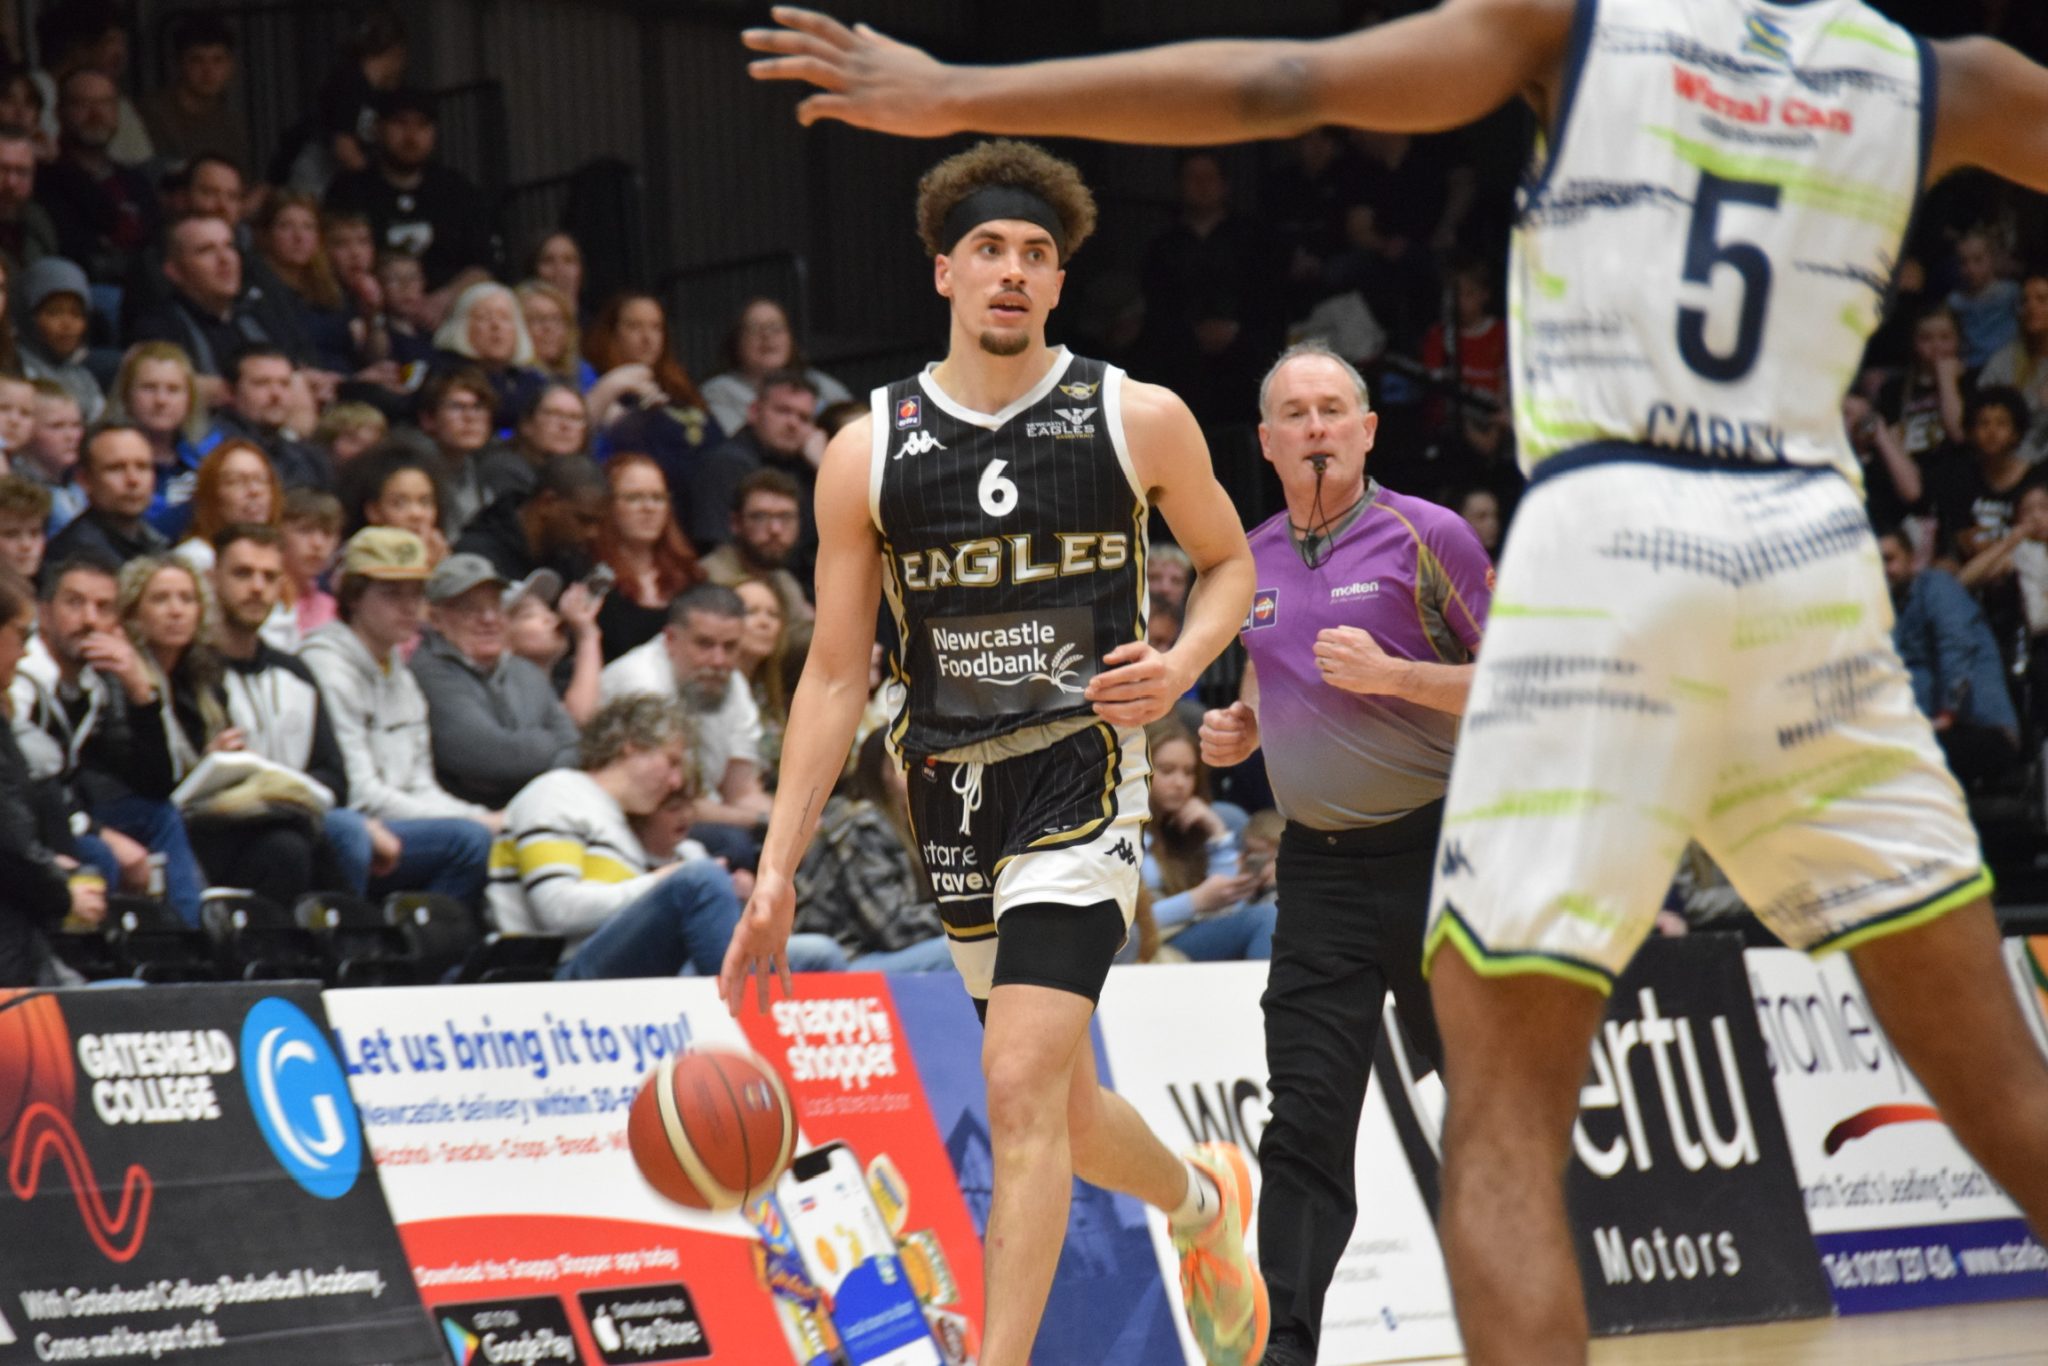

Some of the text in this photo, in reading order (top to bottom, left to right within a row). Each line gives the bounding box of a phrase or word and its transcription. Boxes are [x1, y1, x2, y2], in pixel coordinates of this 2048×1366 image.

[1676, 171, 1782, 383] 5
[1026, 425, 1096, 438] EAGLES
[978, 458, 1018, 518] 6
[900, 532, 1128, 591] EAGLES
[1331, 581, 1379, 598] molten
[931, 620, 1056, 651] Newcastle
[937, 647, 1049, 677] Foodbank
[331, 1027, 400, 1077] Let
[400, 1033, 448, 1072] us
[445, 1013, 549, 1079] bring
[543, 1012, 581, 1066] it
[579, 1018, 620, 1064] to
[771, 997, 882, 1046] snappy
[77, 1029, 237, 1080] GATESHEAD
[786, 1041, 898, 1091] shopper
[91, 1075, 222, 1126] COLLEGE
[1572, 986, 1761, 1179] ertu
[1592, 1224, 1741, 1285] Motors
[19, 1288, 68, 1320] With
